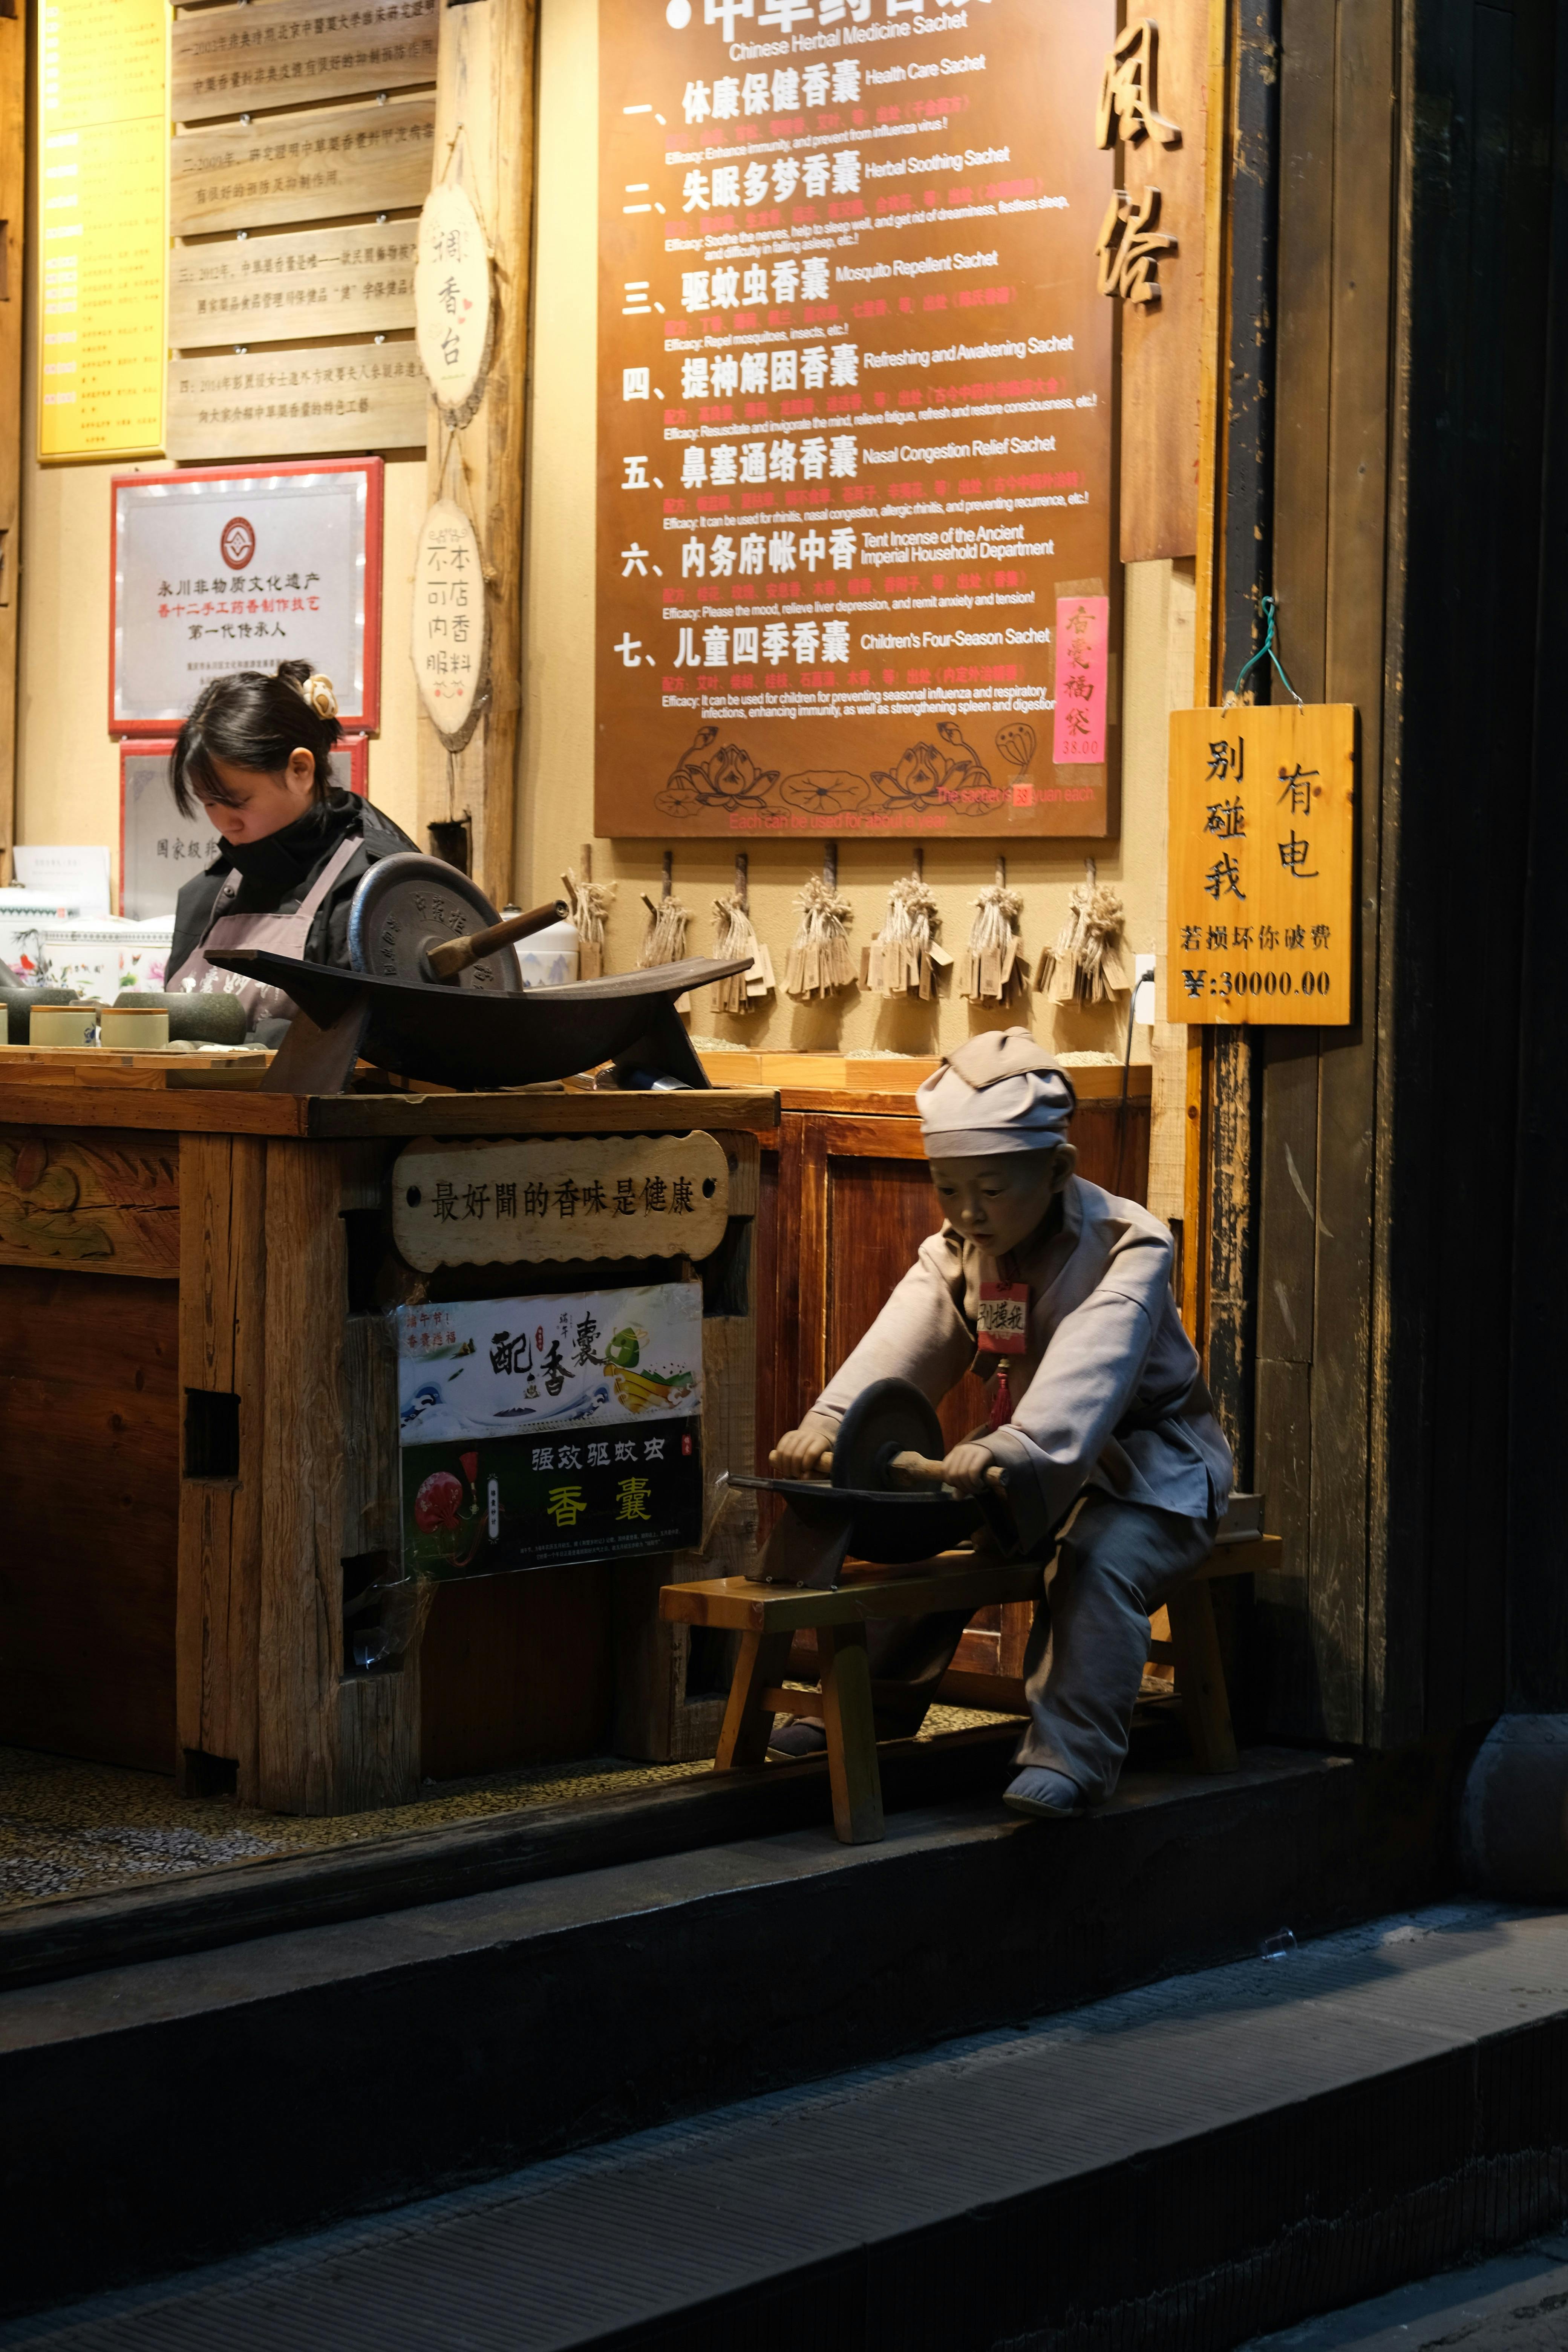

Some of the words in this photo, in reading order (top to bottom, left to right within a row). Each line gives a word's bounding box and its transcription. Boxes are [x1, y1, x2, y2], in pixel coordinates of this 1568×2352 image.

[729, 40, 790, 61] Chinese
[791, 28, 841, 52] Herbal
[843, 21, 911, 44] Medicine
[913, 9, 968, 34] Sachet
[865, 65, 906, 85] Health
[907, 62, 940, 80] Care
[940, 54, 986, 75] Sachet
[682, 150, 861, 213] 失眠多梦香囊
[865, 158, 906, 179] Herbal
[907, 153, 963, 173] Soothing
[964, 145, 1010, 166] Sachet
[681, 257, 830, 312] 驱蚊虫香囊
[835, 262, 892, 282] Mosquito
[893, 255, 952, 278] Repellent
[952, 250, 998, 270] Sachet
[704, 334, 733, 349] Repel
[681, 343, 859, 400] 提神解困香囊
[864, 349, 930, 368] Refreshing
[931, 345, 957, 363] and
[957, 339, 1026, 360] Awakening
[1027, 334, 1074, 354] Sachet
[680, 434, 858, 488] 鼻塞通络香囊
[862, 446, 899, 464] Nasal
[900, 442, 971, 464] Congestion
[972, 437, 1009, 456] Relief
[1010, 435, 1056, 454] Sachet
[706, 517, 723, 527] can
[723, 514, 737, 526] be
[737, 512, 759, 525] used
[759, 511, 773, 524] for
[804, 508, 829, 521] nasal
[945, 499, 965, 513] and
[964, 496, 1015, 514] preventing
[682, 527, 856, 578] 内务府帐中香
[861, 532, 889, 548] Tent
[890, 531, 939, 547] Incense
[940, 527, 956, 544] of
[955, 527, 977, 543] the
[976, 524, 1024, 542] Ancient
[861, 546, 909, 567] Imperial
[911, 542, 978, 562] Household
[980, 539, 1054, 561] Department
[158, 571, 321, 597] 永川非物质文化遗产
[427, 546, 448, 674] 不可内服
[450, 545, 471, 673] 本店香料
[662, 607, 700, 621] Efficacy:
[702, 605, 734, 617] Please
[735, 604, 750, 616] the
[751, 603, 781, 616] mood,
[782, 602, 814, 614] relieve
[814, 601, 835, 612] liver
[835, 598, 891, 614] depression,
[891, 597, 911, 609] and
[912, 595, 937, 608] remit
[938, 594, 974, 609] anxiety
[974, 593, 994, 606] and
[995, 590, 1035, 605] tension!
[188, 621, 286, 640] 第一代传承人
[673, 620, 850, 668] 儿童四季香囊
[861, 632, 921, 650] Children's
[922, 630, 1003, 648] Four-Season
[1005, 627, 1050, 644] Sachet
[662, 695, 700, 709] Efficacy:
[701, 694, 708, 706] It
[709, 696, 727, 706] can
[727, 694, 740, 705] be
[741, 692, 764, 705] used
[765, 692, 778, 704] for
[779, 692, 816, 704] children
[817, 690, 831, 703] for
[831, 689, 882, 706] preventing
[882, 687, 926, 701] seasonal
[927, 686, 972, 699] influenza
[972, 685, 992, 698] and
[993, 684, 1047, 701] respiratory
[701, 706, 747, 719] infections,
[748, 705, 797, 719] enhancing
[843, 705, 856, 715] as
[856, 702, 876, 715] well
[877, 704, 890, 714] as
[890, 700, 957, 716] strengthening
[957, 699, 991, 715] spleen
[992, 698, 1012, 712] and
[1062, 740, 1098, 754] 38.00
[936, 785, 960, 802] The
[961, 785, 1000, 802] sachet
[729, 811, 762, 830] Each
[765, 814, 789, 830] can
[792, 811, 807, 830] be
[811, 811, 846, 830] used
[847, 810, 862, 829] for
[864, 810, 902, 828] about
[905, 813, 914, 828] a
[917, 813, 947, 833] year
[1203, 735, 1246, 901] 别碰我
[1276, 763, 1320, 878] 有电
[1180, 924, 1332, 951] 若损坏你破费
[431, 1176, 696, 1223] 最好聞的香味是健康
[532, 1436, 665, 1471] 强效驱蚊虫
